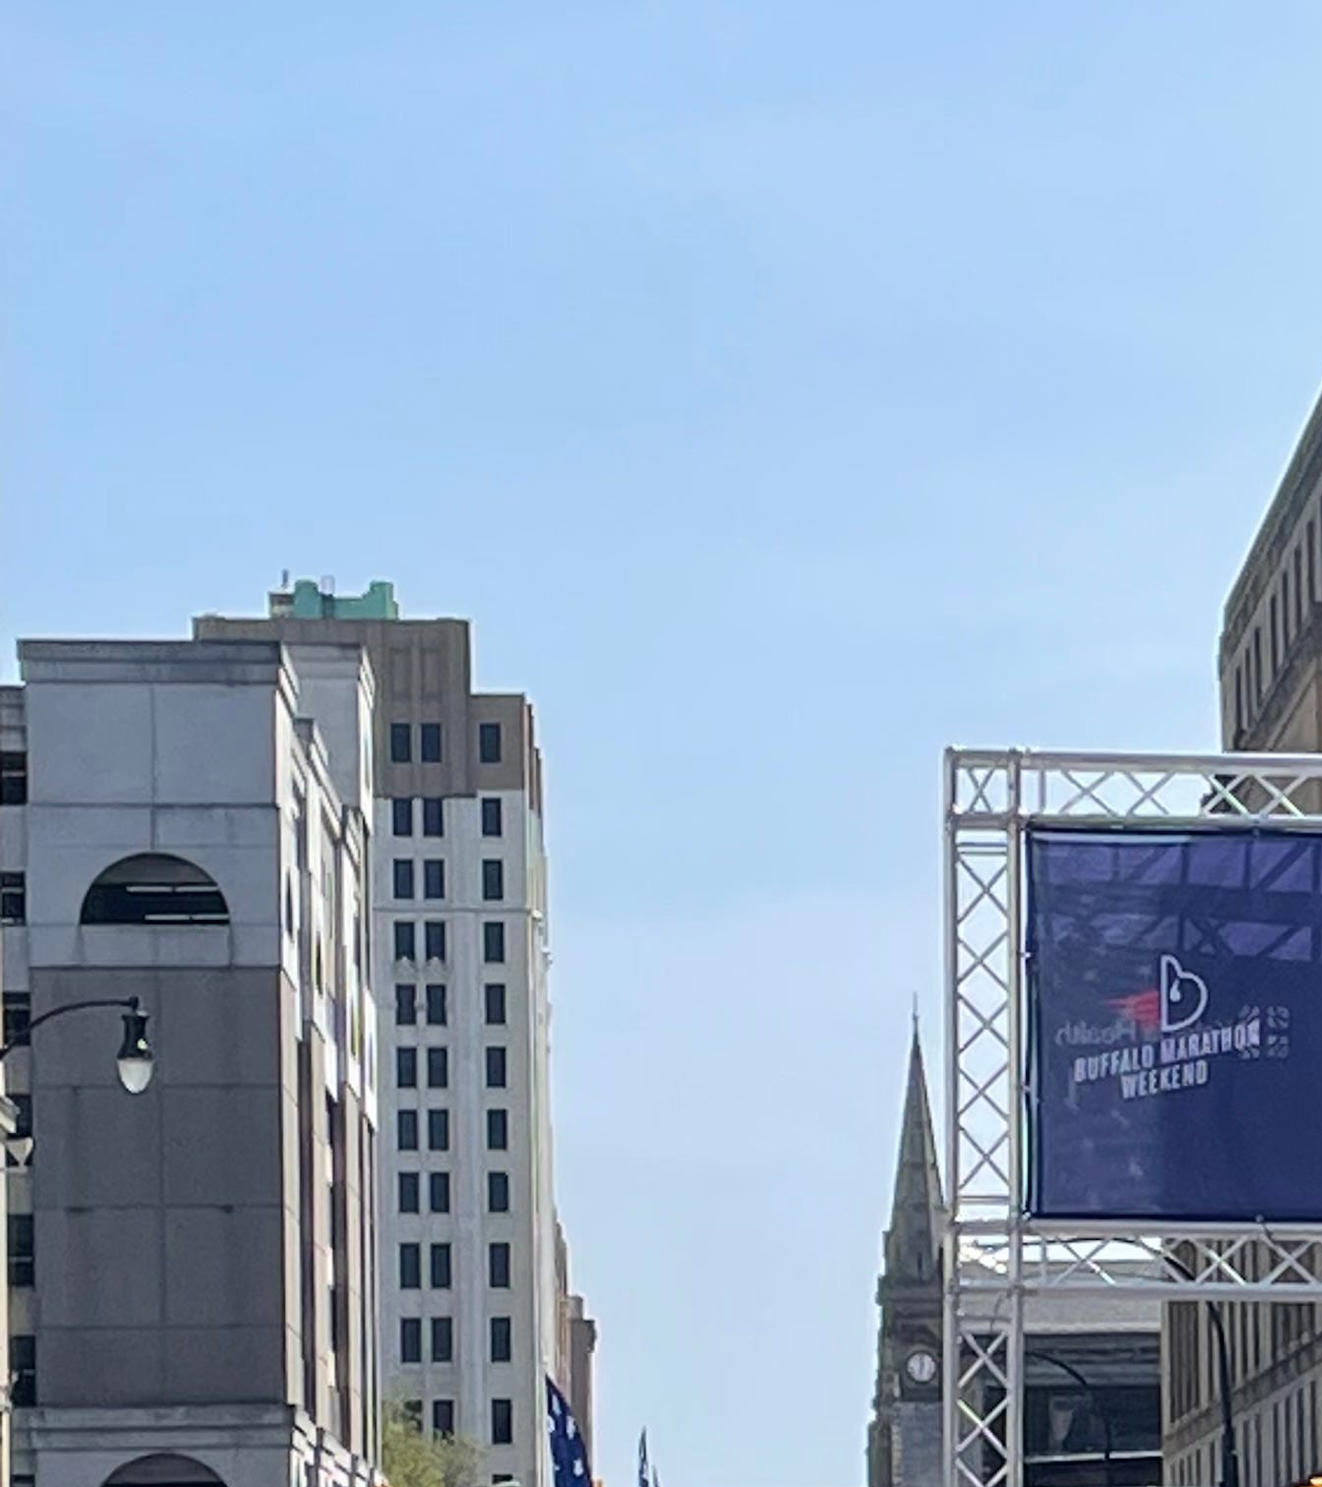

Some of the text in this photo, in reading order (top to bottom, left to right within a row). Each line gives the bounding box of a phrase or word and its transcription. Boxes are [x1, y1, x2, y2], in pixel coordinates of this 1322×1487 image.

[1073, 1018, 1262, 1083] BUFFALO MARATHON
[1120, 1059, 1209, 1099] WEEKEND
